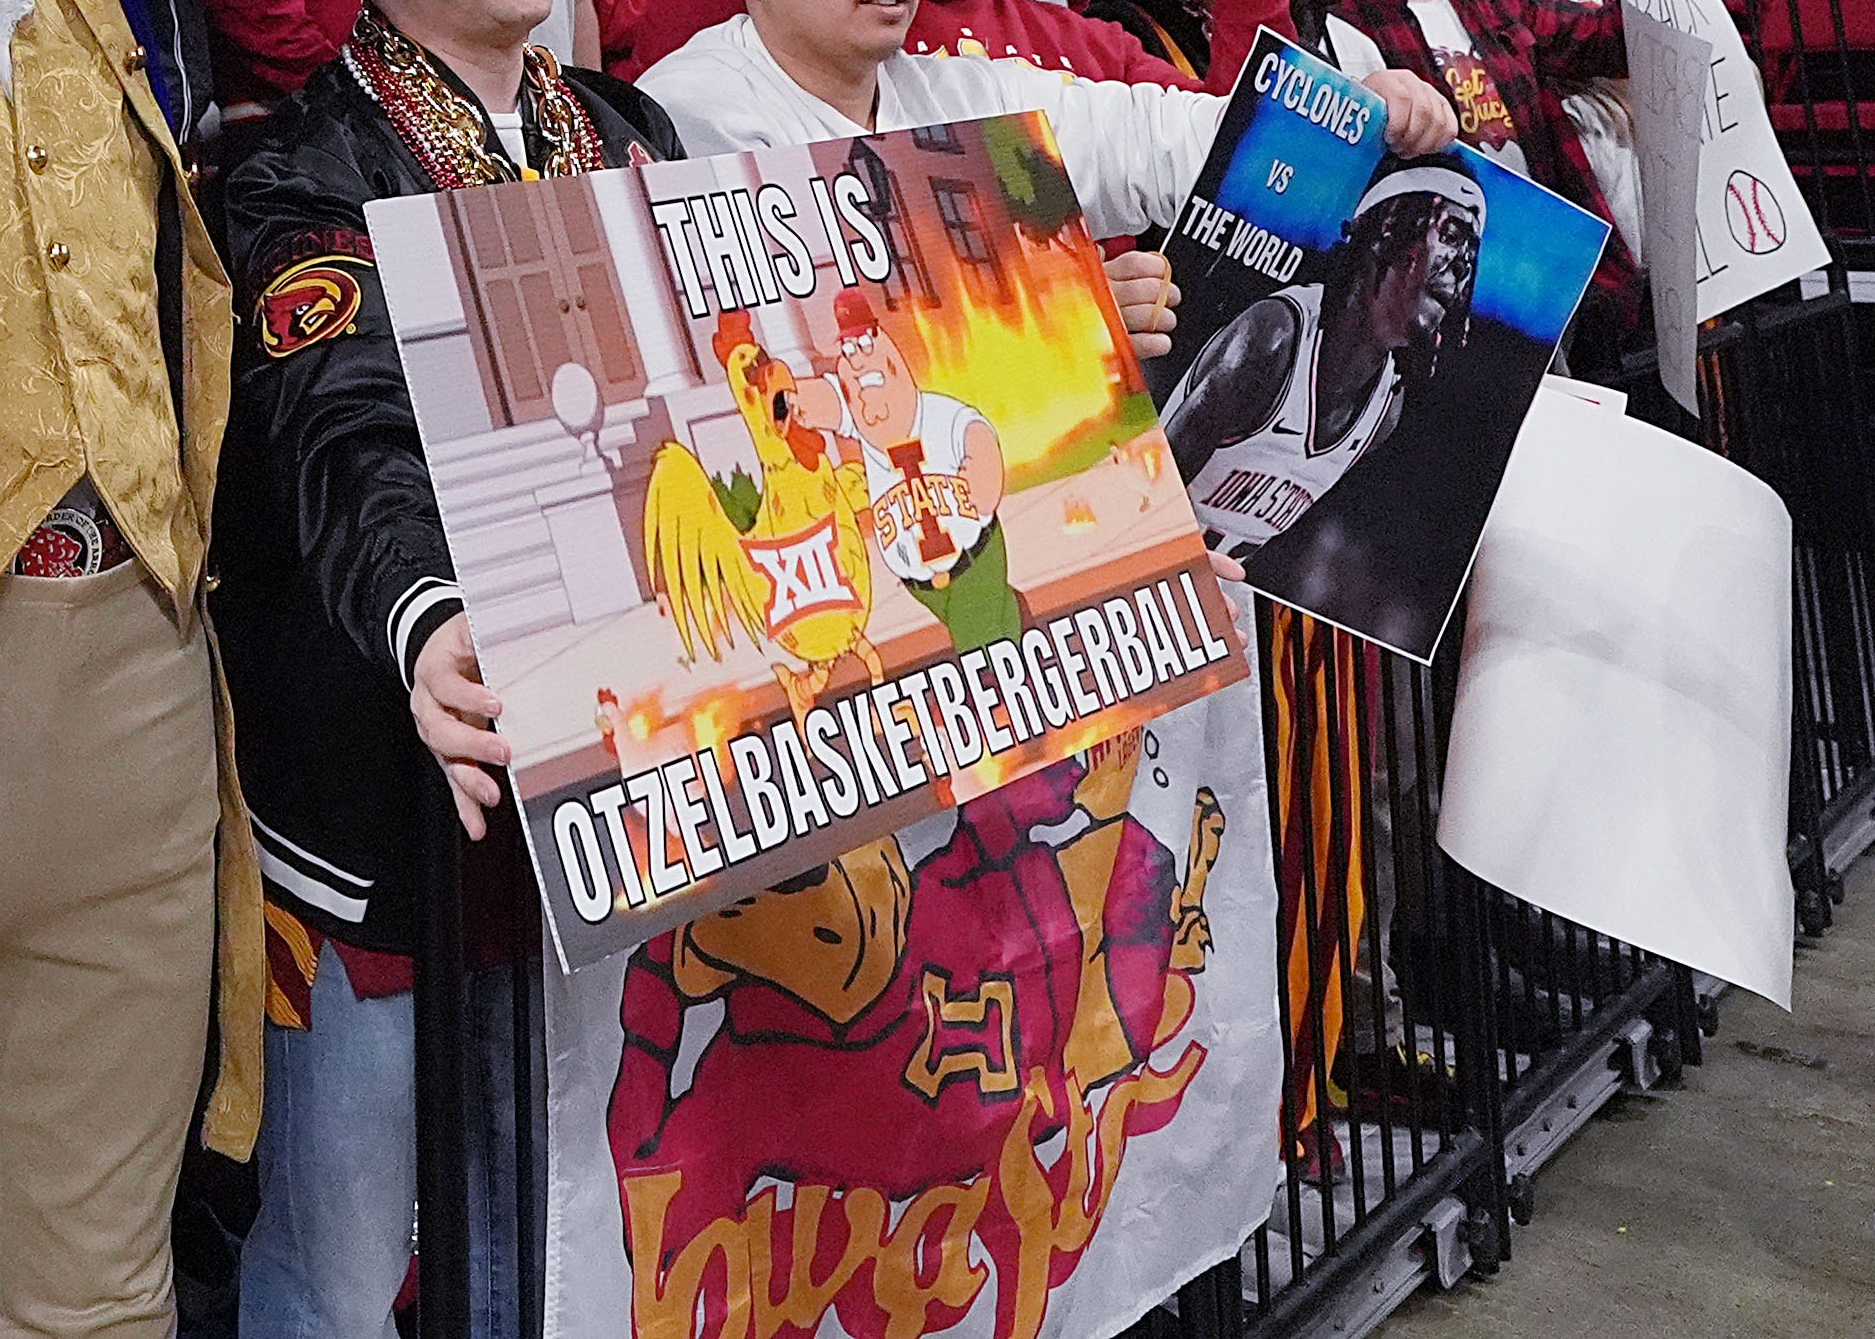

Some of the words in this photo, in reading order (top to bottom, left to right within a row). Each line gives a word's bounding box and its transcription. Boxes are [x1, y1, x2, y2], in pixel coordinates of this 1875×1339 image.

[1254, 52, 1370, 145] CYCLONES
[1266, 159, 1294, 193] VS
[650, 182, 817, 320] THIS
[810, 173, 893, 286] IS
[1182, 196, 1234, 250] THE
[1226, 219, 1303, 283] WORLD
[873, 473, 979, 550] STATE
[1200, 470, 1277, 514] IOWA
[749, 525, 853, 627] XII
[551, 569, 1233, 928] OTZELBASKETBERGERBALL
